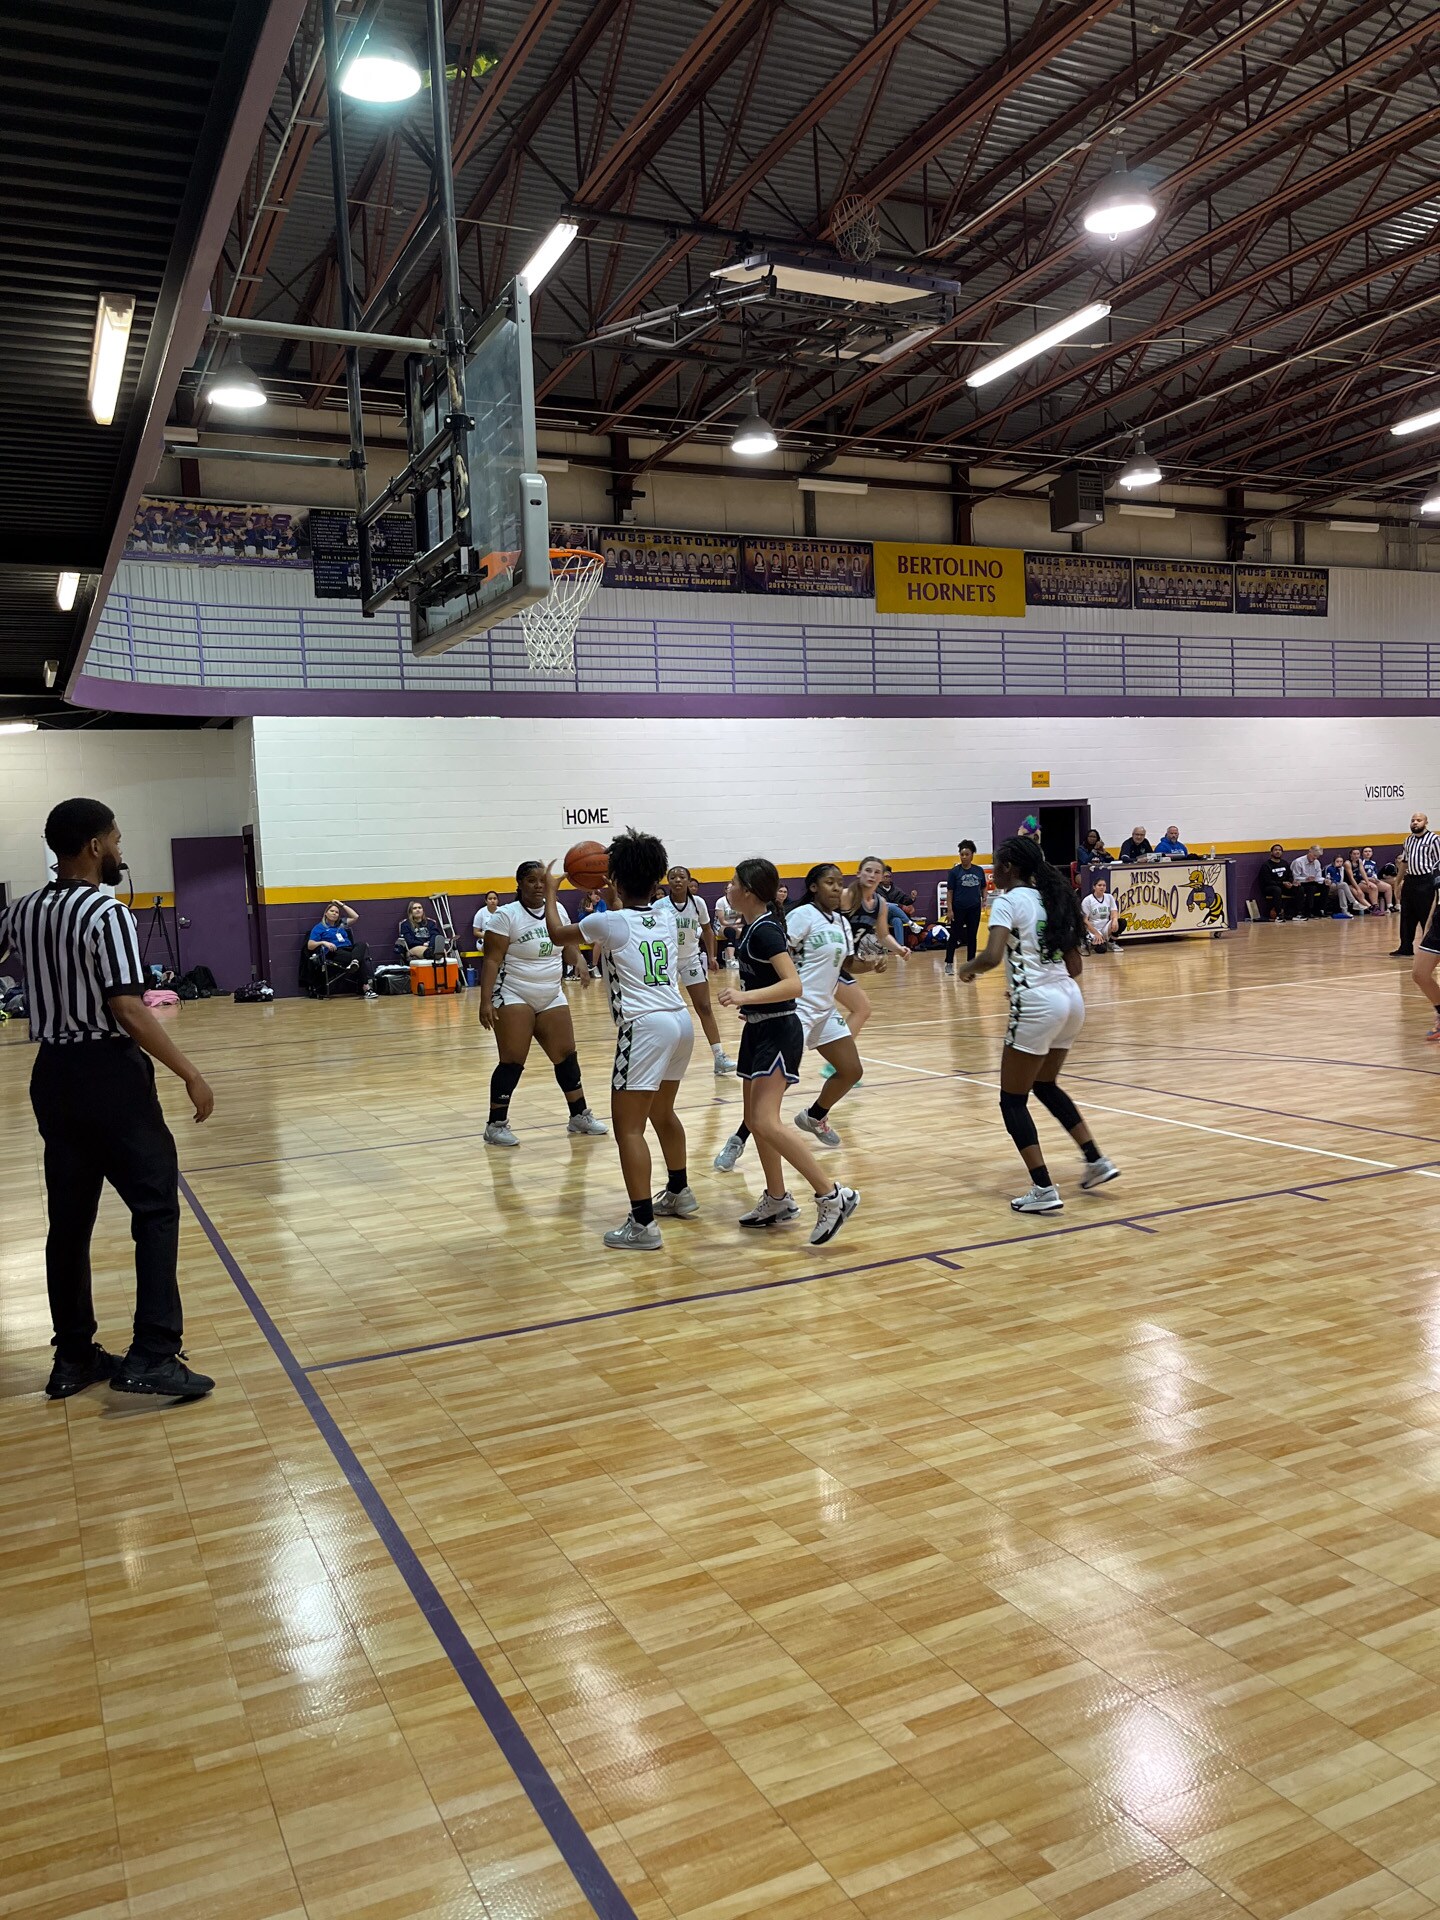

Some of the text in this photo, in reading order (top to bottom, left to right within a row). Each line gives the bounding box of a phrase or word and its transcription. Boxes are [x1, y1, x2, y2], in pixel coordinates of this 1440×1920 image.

[603, 531, 739, 548] MUSS-BERTOLINO
[746, 540, 870, 555] MUSS-BERTOLINO
[897, 556, 1004, 579] BERTOLINO
[672, 577, 690, 585] CITY
[691, 577, 731, 586] CHAMPIONS
[816, 584, 853, 592] CHAMPIONS
[907, 582, 996, 602] HORNETS
[1365, 784, 1405, 798] VISITORS
[566, 808, 609, 825] HOME
[1130, 871, 1160, 886] MUSS
[1120, 912, 1173, 931] Hornets
[639, 940, 670, 986] 12
